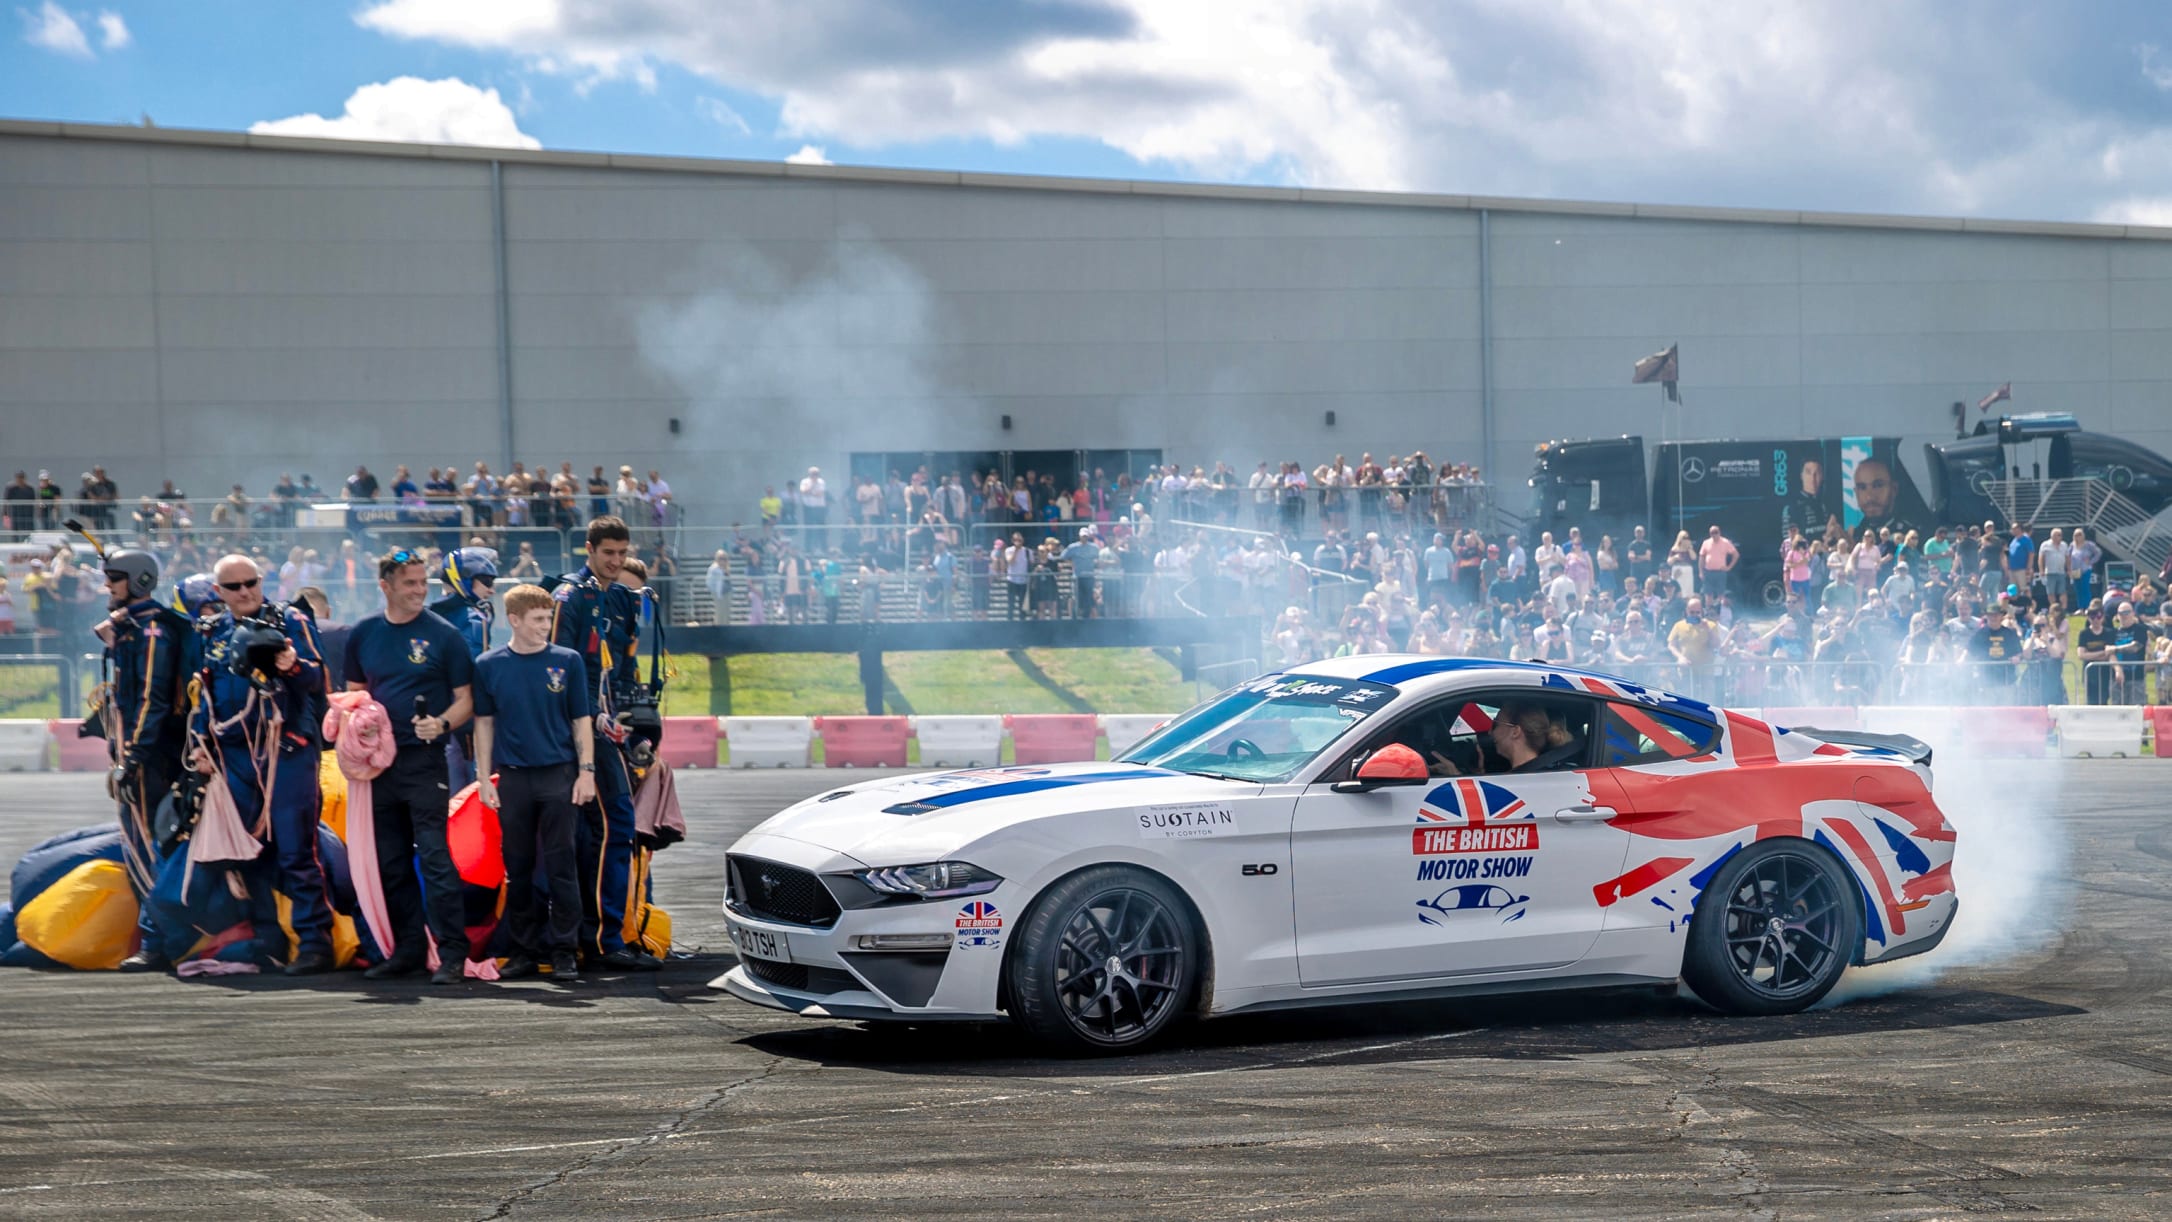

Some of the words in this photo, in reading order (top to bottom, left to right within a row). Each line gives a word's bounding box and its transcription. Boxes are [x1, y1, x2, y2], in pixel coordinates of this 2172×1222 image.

[1773, 449, 1788, 496] GR63
[1177, 829, 1213, 837] CORYTON
[1424, 830, 1456, 852] THE
[1459, 827, 1529, 851] BRITISH
[1417, 859, 1480, 881] MOTOR
[1480, 856, 1533, 879] SHOW
[958, 928, 981, 936] MOTOR
[981, 928, 1001, 936] SHOW
[960, 919, 973, 927] THE
[973, 919, 998, 927] BRITISH
[752, 931, 778, 957] TSH
